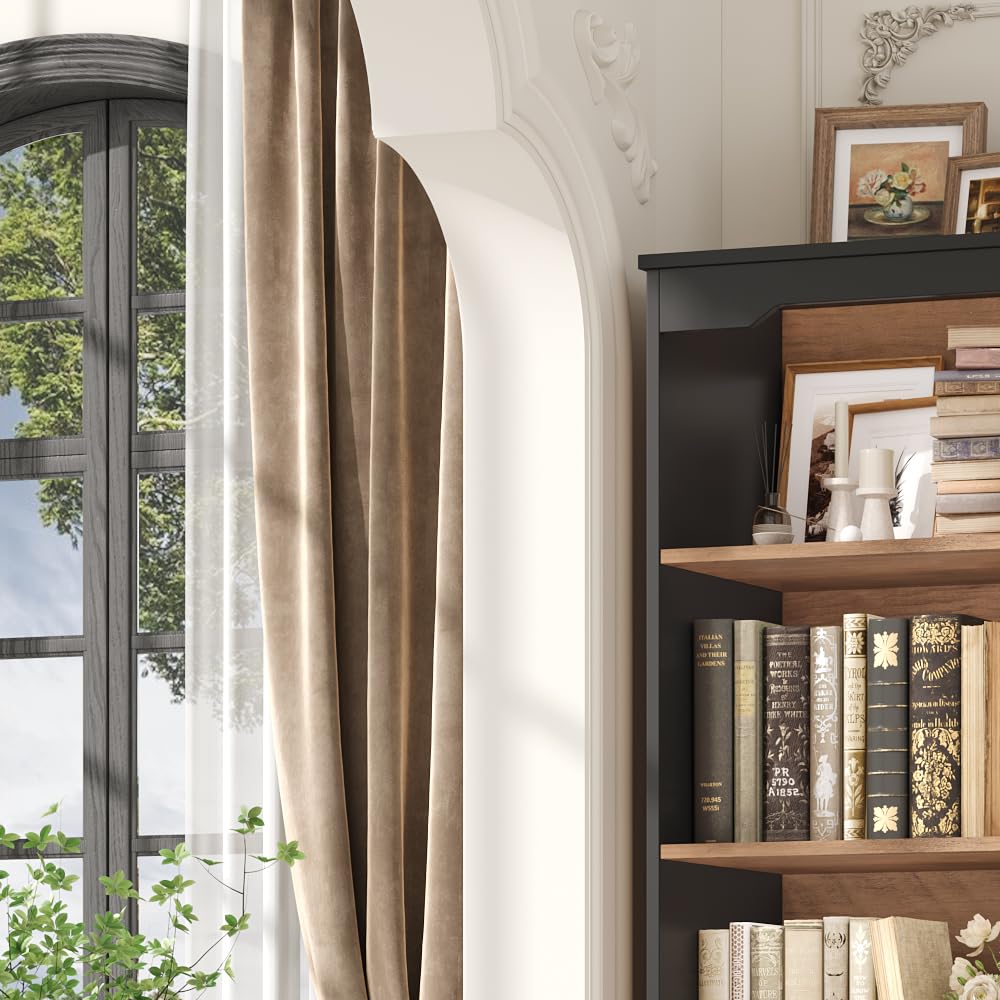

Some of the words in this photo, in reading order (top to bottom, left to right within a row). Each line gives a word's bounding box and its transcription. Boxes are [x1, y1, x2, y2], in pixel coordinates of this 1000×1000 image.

[769, 670, 799, 678] WORKS
[771, 701, 797, 709] HENRY
[771, 767, 790, 777] PR
[771, 777, 796, 787] 5790
